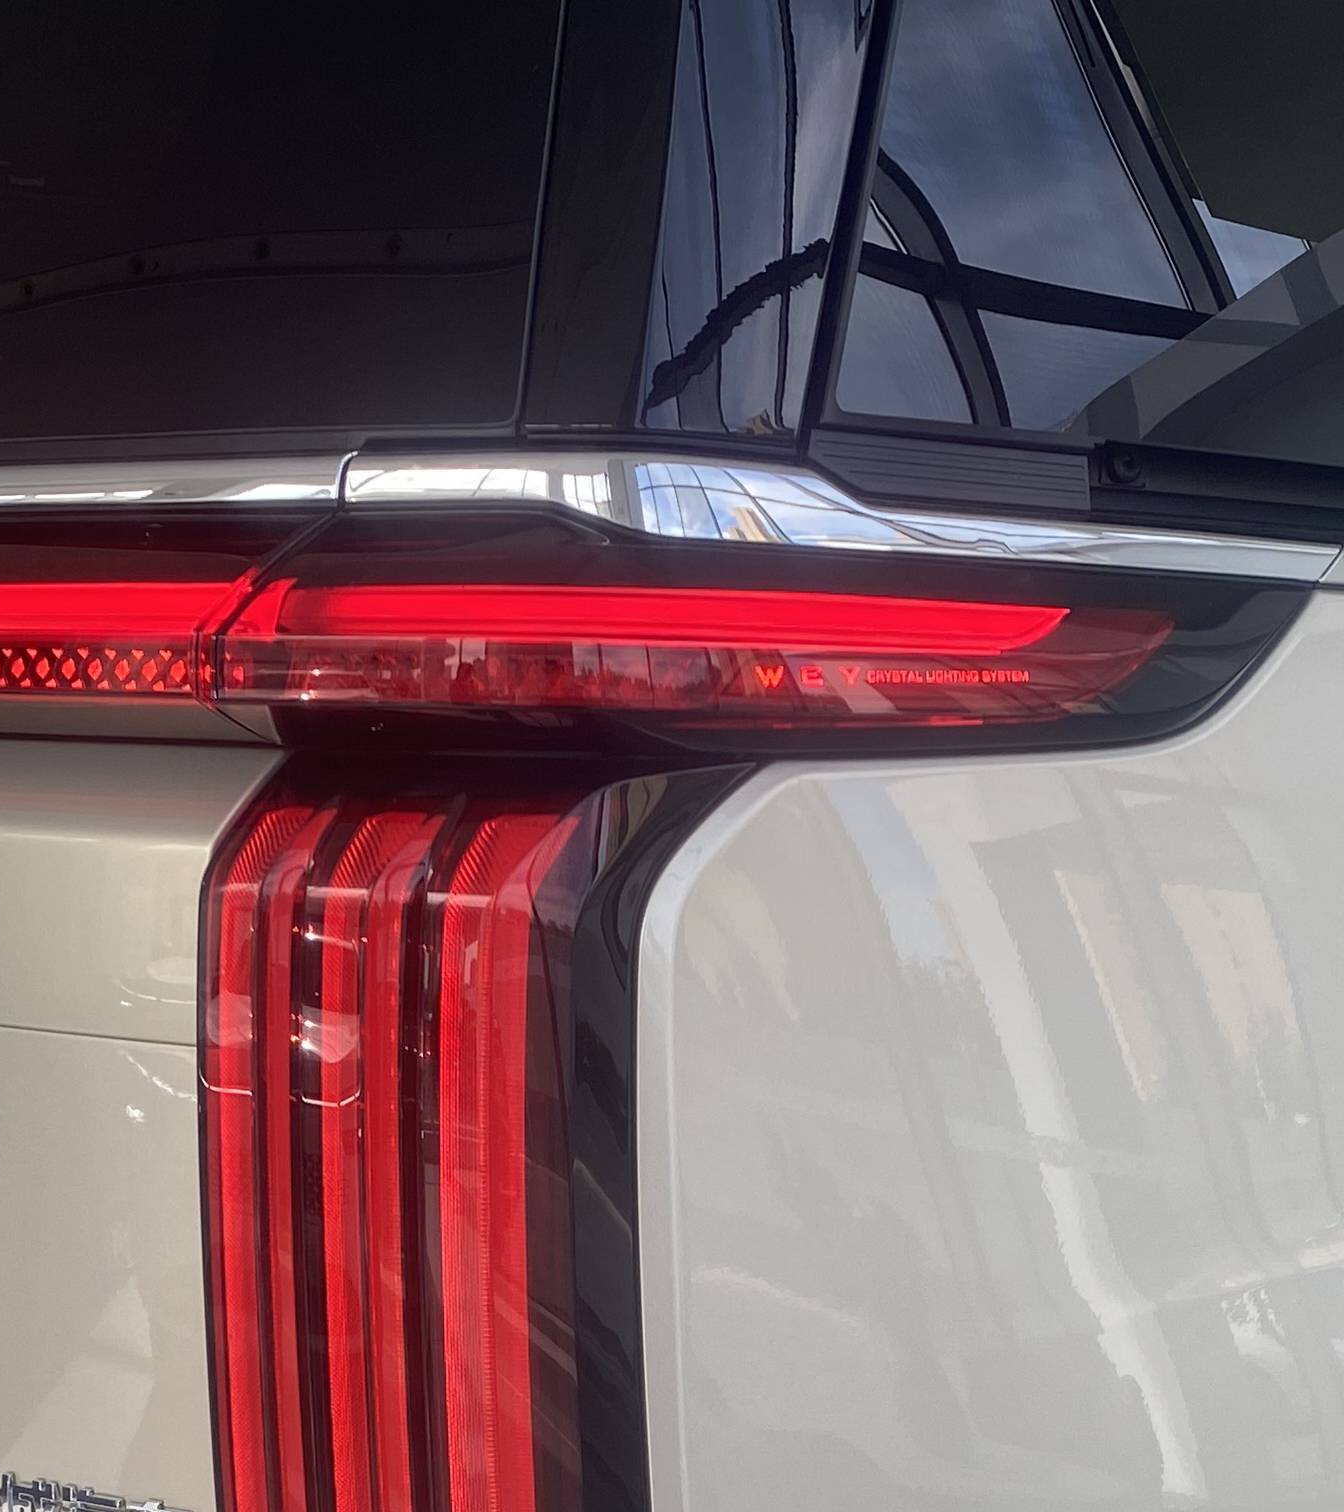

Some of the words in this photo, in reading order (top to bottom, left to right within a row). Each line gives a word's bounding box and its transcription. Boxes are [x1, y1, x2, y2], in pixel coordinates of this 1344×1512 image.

[755, 665, 860, 688] WEY
[867, 669, 923, 683] CRYSTAL
[981, 669, 1030, 684] SYSTEM
